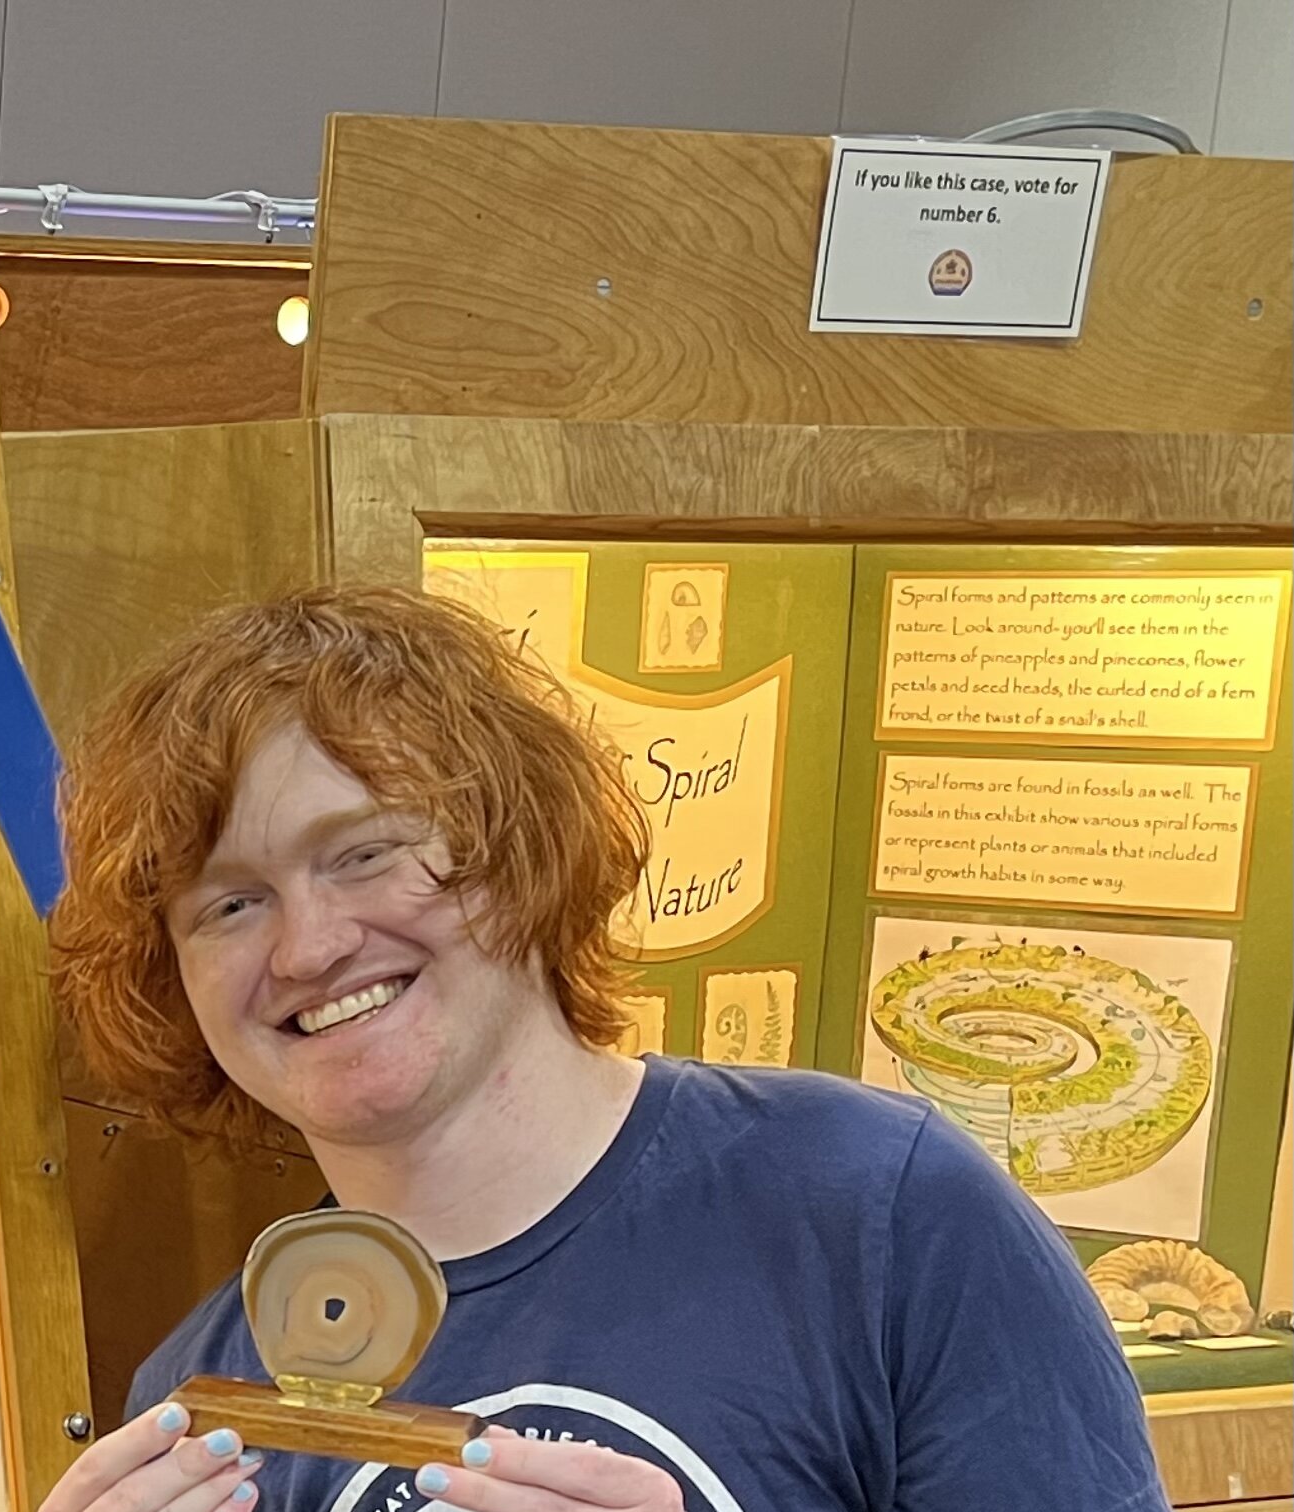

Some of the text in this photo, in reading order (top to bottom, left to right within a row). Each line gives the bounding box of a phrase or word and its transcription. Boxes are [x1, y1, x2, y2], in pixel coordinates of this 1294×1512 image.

[855, 169, 1078, 195] If you like this case, vote for
[920, 205, 1000, 223] number 6.
[897, 586, 1273, 611] Spiral forms and patterns are commonly seen in
[953, 616, 994, 635] Look
[1109, 625, 1135, 634] see
[1141, 618, 1178, 634] them
[1184, 626, 1197, 634] in
[1203, 618, 1228, 635] the
[893, 646, 1245, 673] patterns of pineapples and pinecones, flower
[891, 675, 936, 698] petals
[941, 676, 969, 693] and
[972, 677, 1009, 693] seed
[1013, 677, 1063, 698] heads,
[1068, 678, 1092, 695] the
[1097, 678, 1146, 696] curled
[1150, 680, 1181, 698] end
[1184, 680, 1204, 698] of
[1207, 689, 1217, 698] a
[889, 703, 932, 722] frond,
[937, 713, 953, 721] or
[957, 705, 980, 723] the
[986, 712, 1020, 724] twist
[1024, 707, 1043, 724] of
[1045, 716, 1054, 725] a
[1058, 709, 1105, 727] snail's
[634, 713, 748, 828] Spiral
[890, 771, 940, 795] Spiral
[943, 772, 984, 791] forms
[988, 783, 1012, 792] are
[1017, 776, 1063, 794] found
[1066, 783, 1079, 794] in
[1084, 779, 1133, 797] fossils
[1138, 789, 1156, 797] as
[1204, 783, 1240, 803] The
[888, 800, 1237, 836] fossils in this exhibit show various spiral forms
[885, 835, 1218, 862] or represent plants or animals that included
[884, 860, 922, 881] spiral
[924, 863, 976, 883] growth
[980, 864, 1026, 881] habits
[1031, 871, 1044, 883] in
[1049, 875, 1088, 885] some
